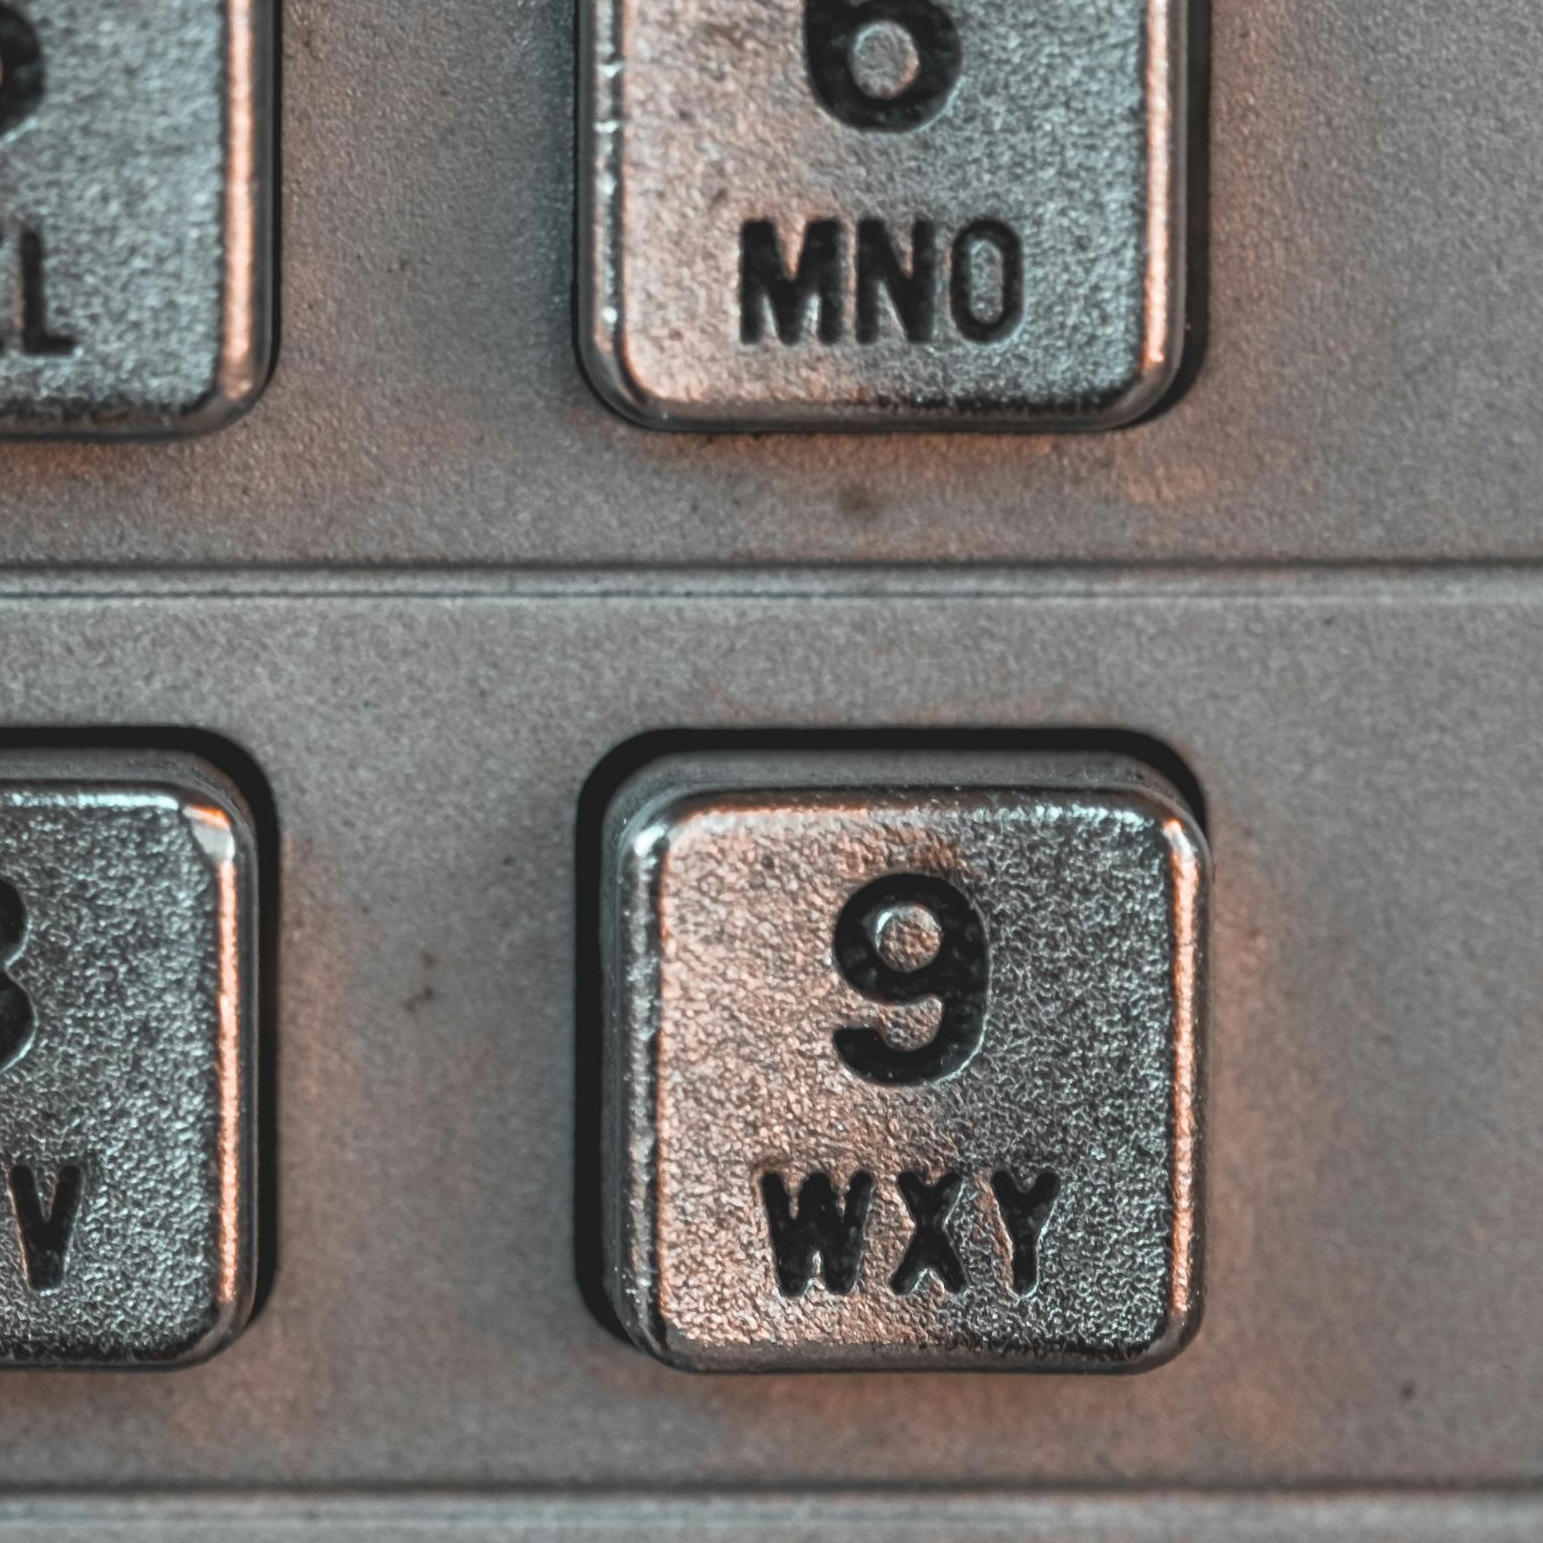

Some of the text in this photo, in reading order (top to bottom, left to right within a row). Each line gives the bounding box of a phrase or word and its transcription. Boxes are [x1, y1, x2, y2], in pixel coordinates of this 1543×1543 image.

[740, 218, 1018, 346] MNO
[833, 876, 991, 1085] 9
[766, 1171, 1058, 1297] WXY
